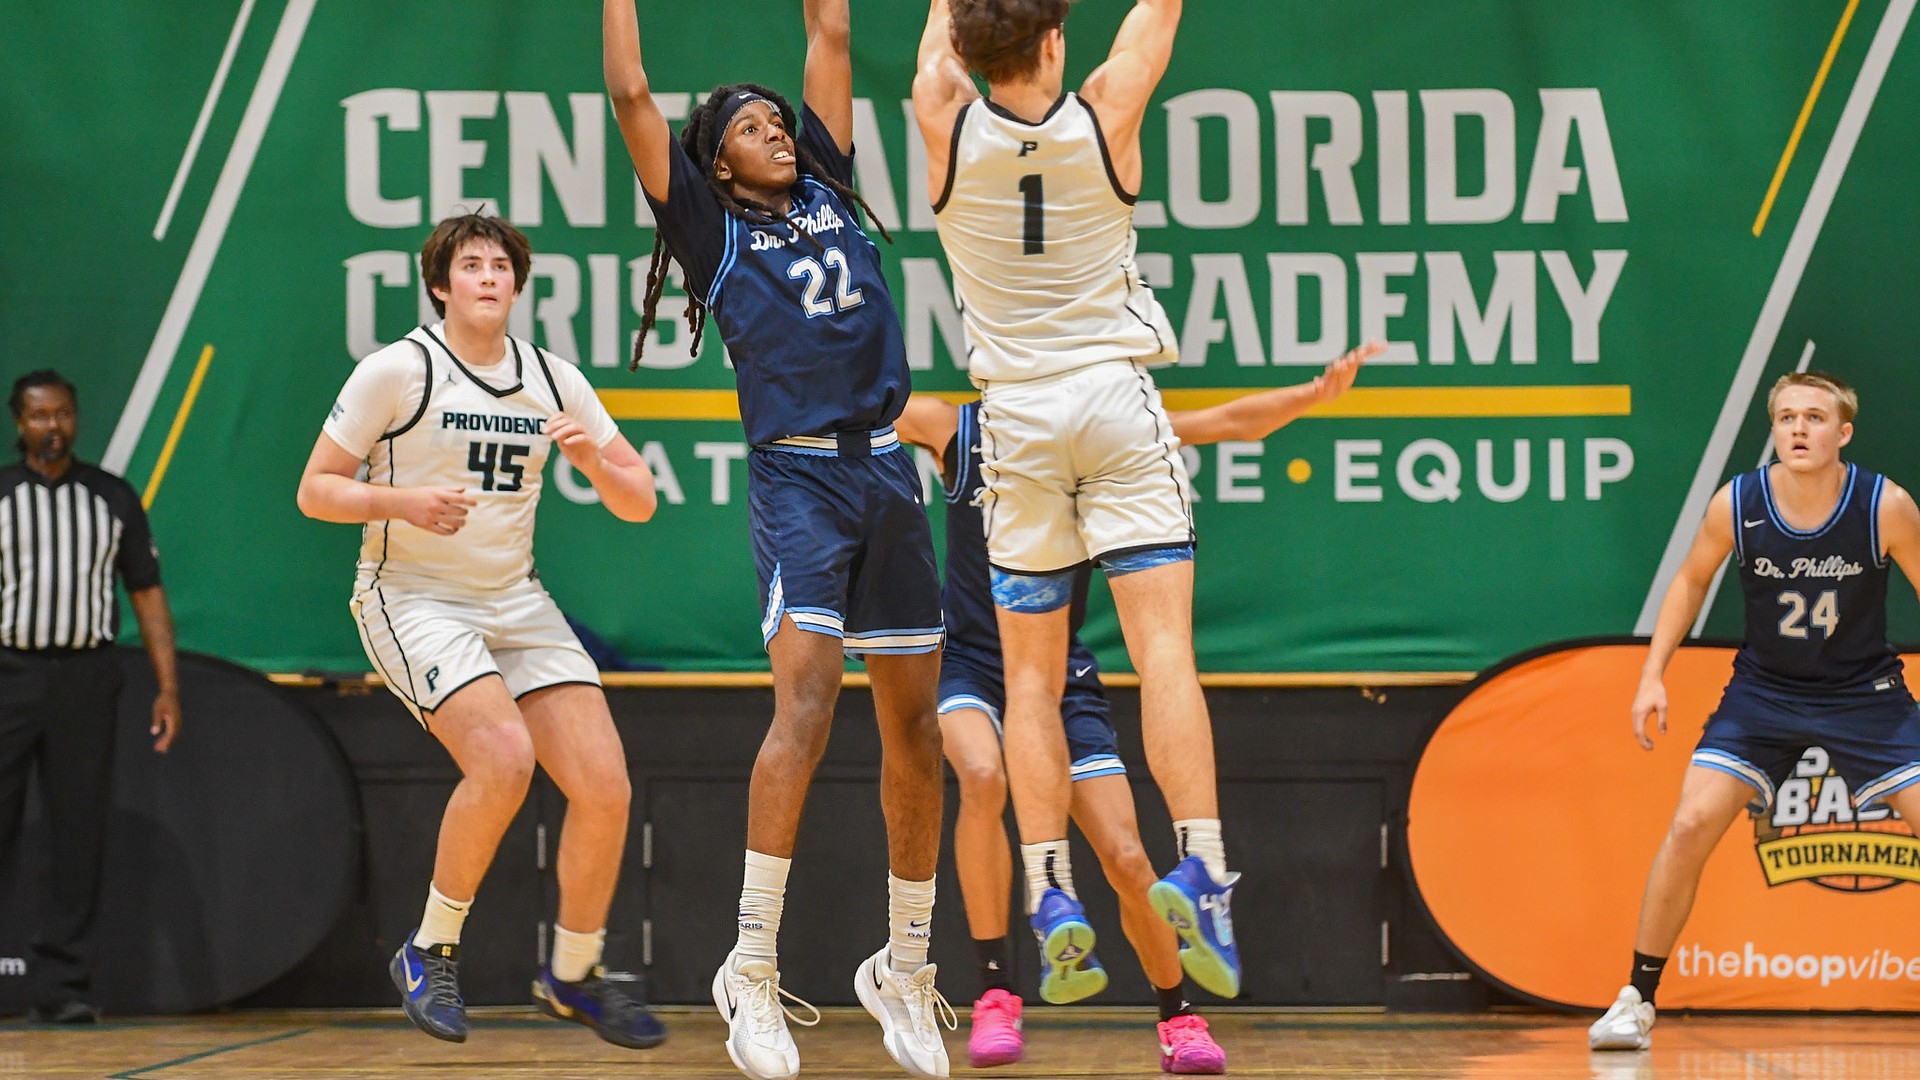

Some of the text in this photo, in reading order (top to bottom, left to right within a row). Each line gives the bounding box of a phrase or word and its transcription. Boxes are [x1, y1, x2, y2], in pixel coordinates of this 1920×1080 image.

[1132, 87, 1629, 230] ORIDA
[751, 203, 845, 251] Dr. Phillip
[1018, 173, 1045, 255] 1
[787, 247, 866, 319] 22
[1134, 249, 1629, 369] ADEMY
[442, 411, 548, 435] PROVIDENC
[467, 441, 530, 491] 45
[1334, 437, 1635, 502] EQUIP
[1754, 555, 1864, 581] Dr. Phillips
[1777, 589, 1841, 639] 24
[1771, 775, 1904, 827] BA
